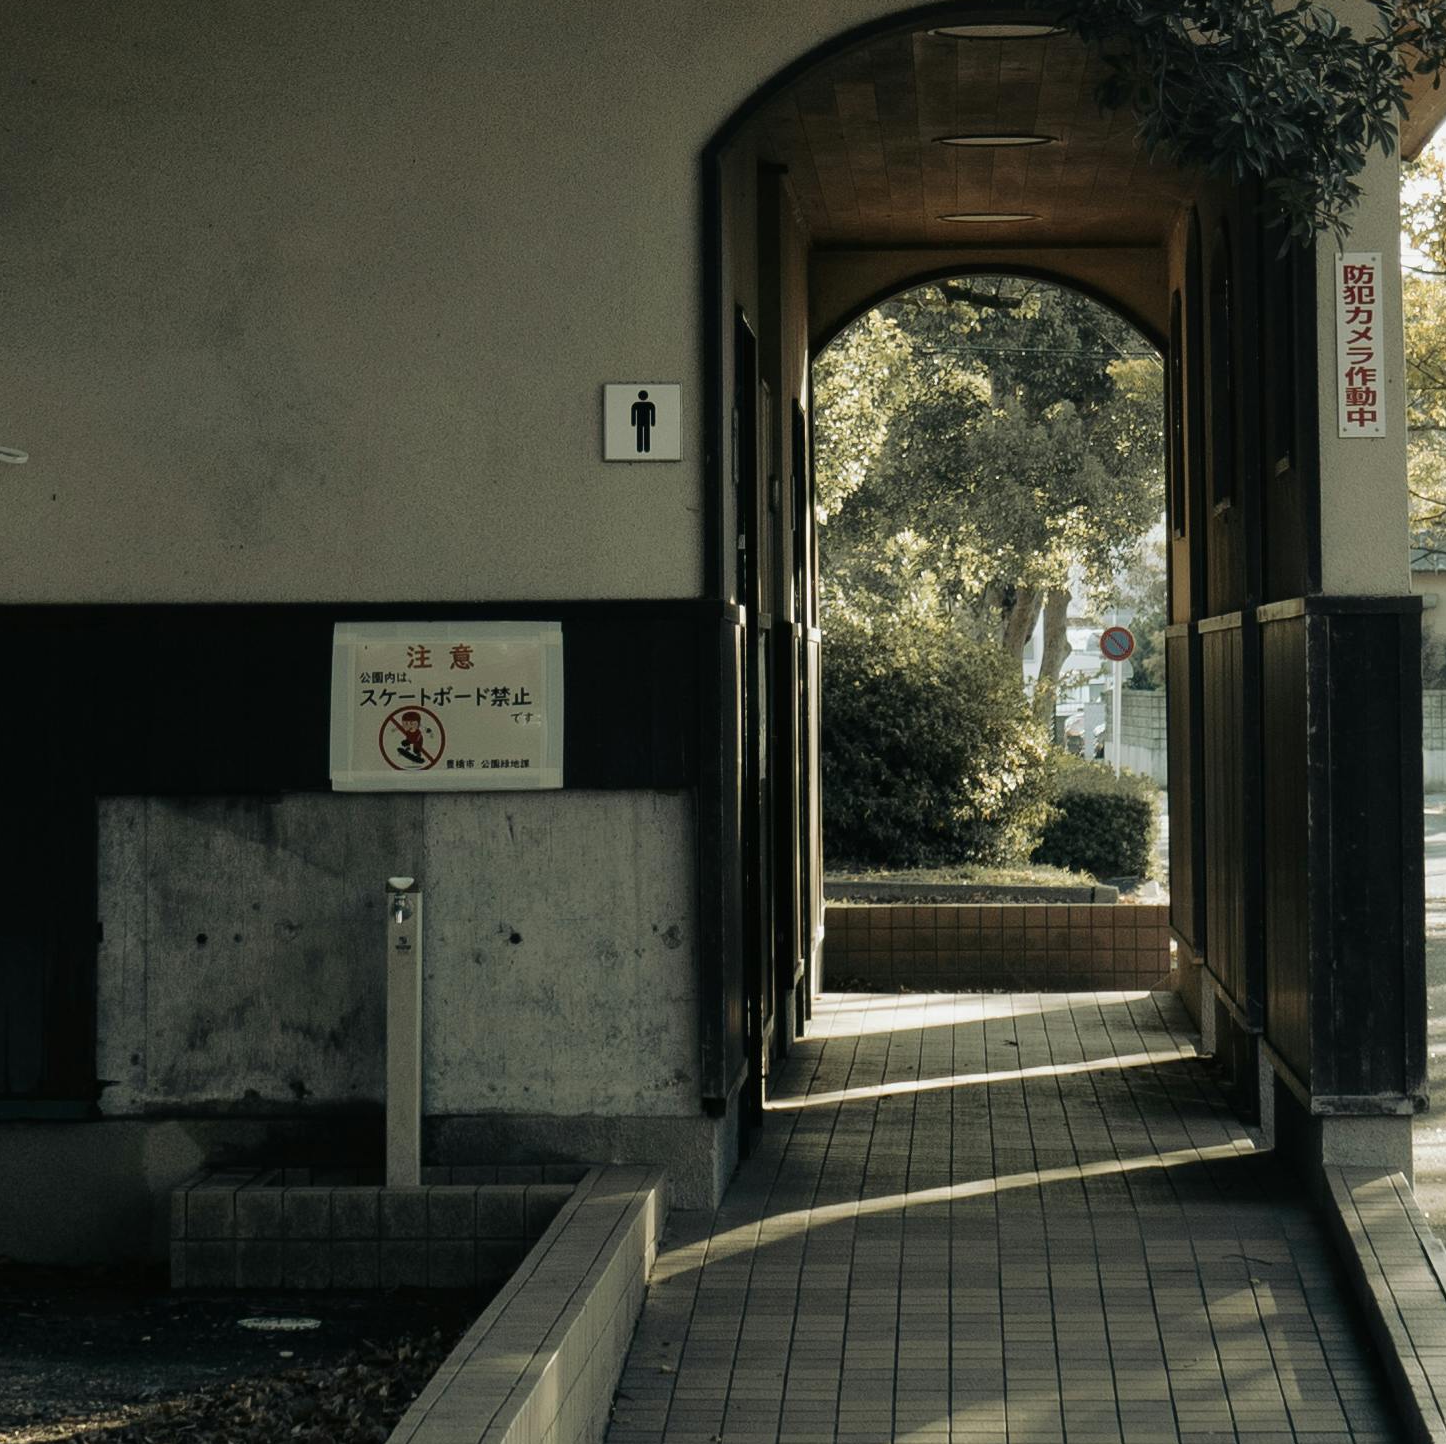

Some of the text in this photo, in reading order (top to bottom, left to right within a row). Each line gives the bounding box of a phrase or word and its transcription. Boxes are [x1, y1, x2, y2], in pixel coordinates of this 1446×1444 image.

[1342, 264, 1377, 427] 防犯カメラ作動中
[406, 643, 474, 670] 注意
[359, 671, 412, 685] 公園内は、
[359, 686, 532, 707] スケートボード禁止
